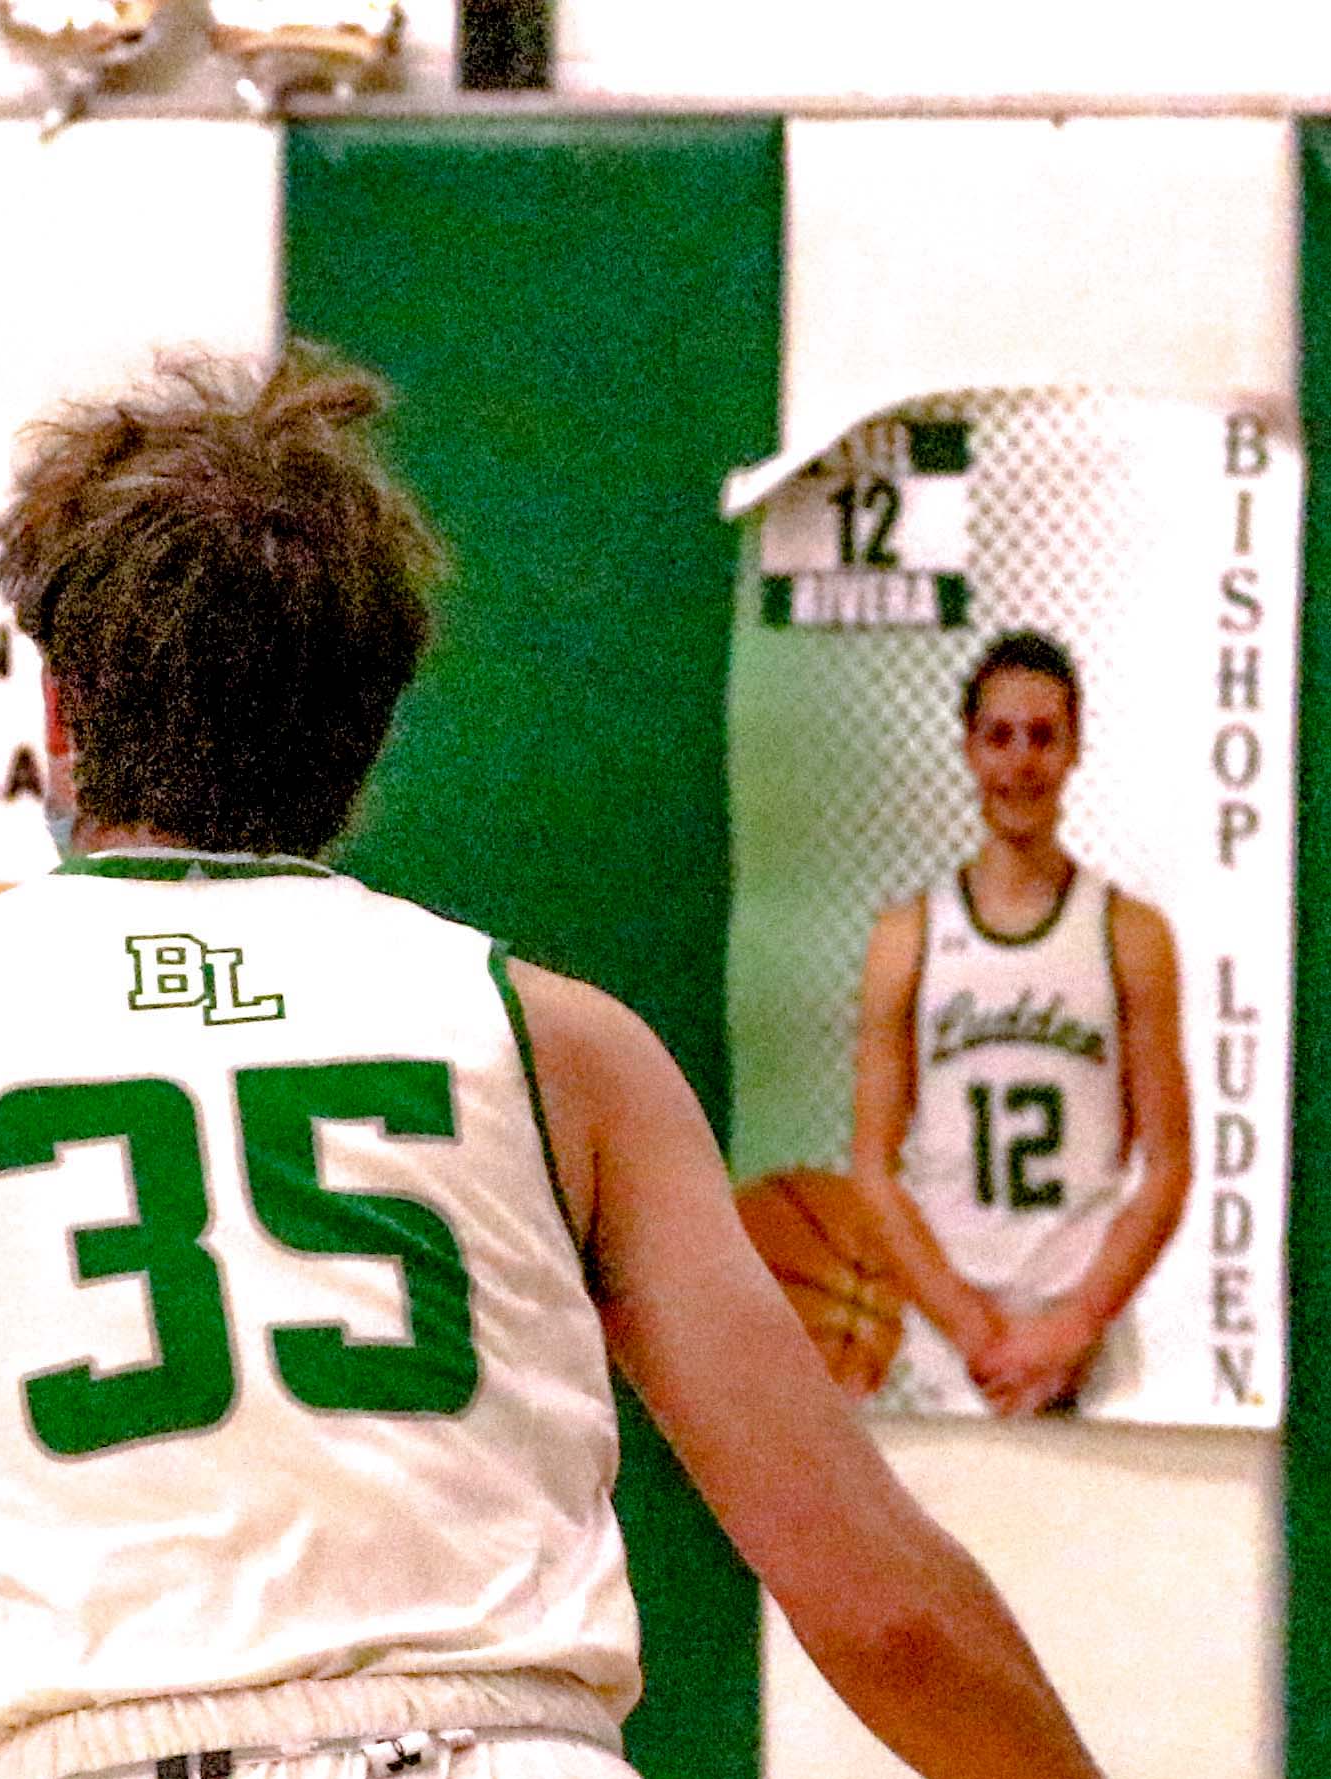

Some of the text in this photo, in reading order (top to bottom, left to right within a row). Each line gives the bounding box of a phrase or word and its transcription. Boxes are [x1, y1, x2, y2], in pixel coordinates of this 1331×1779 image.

[827, 476, 901, 567] 12
[1209, 412, 1271, 1406] BISHOP LUDDEN
[125, 932, 286, 1027] BL
[968, 1080, 1066, 1210] 12
